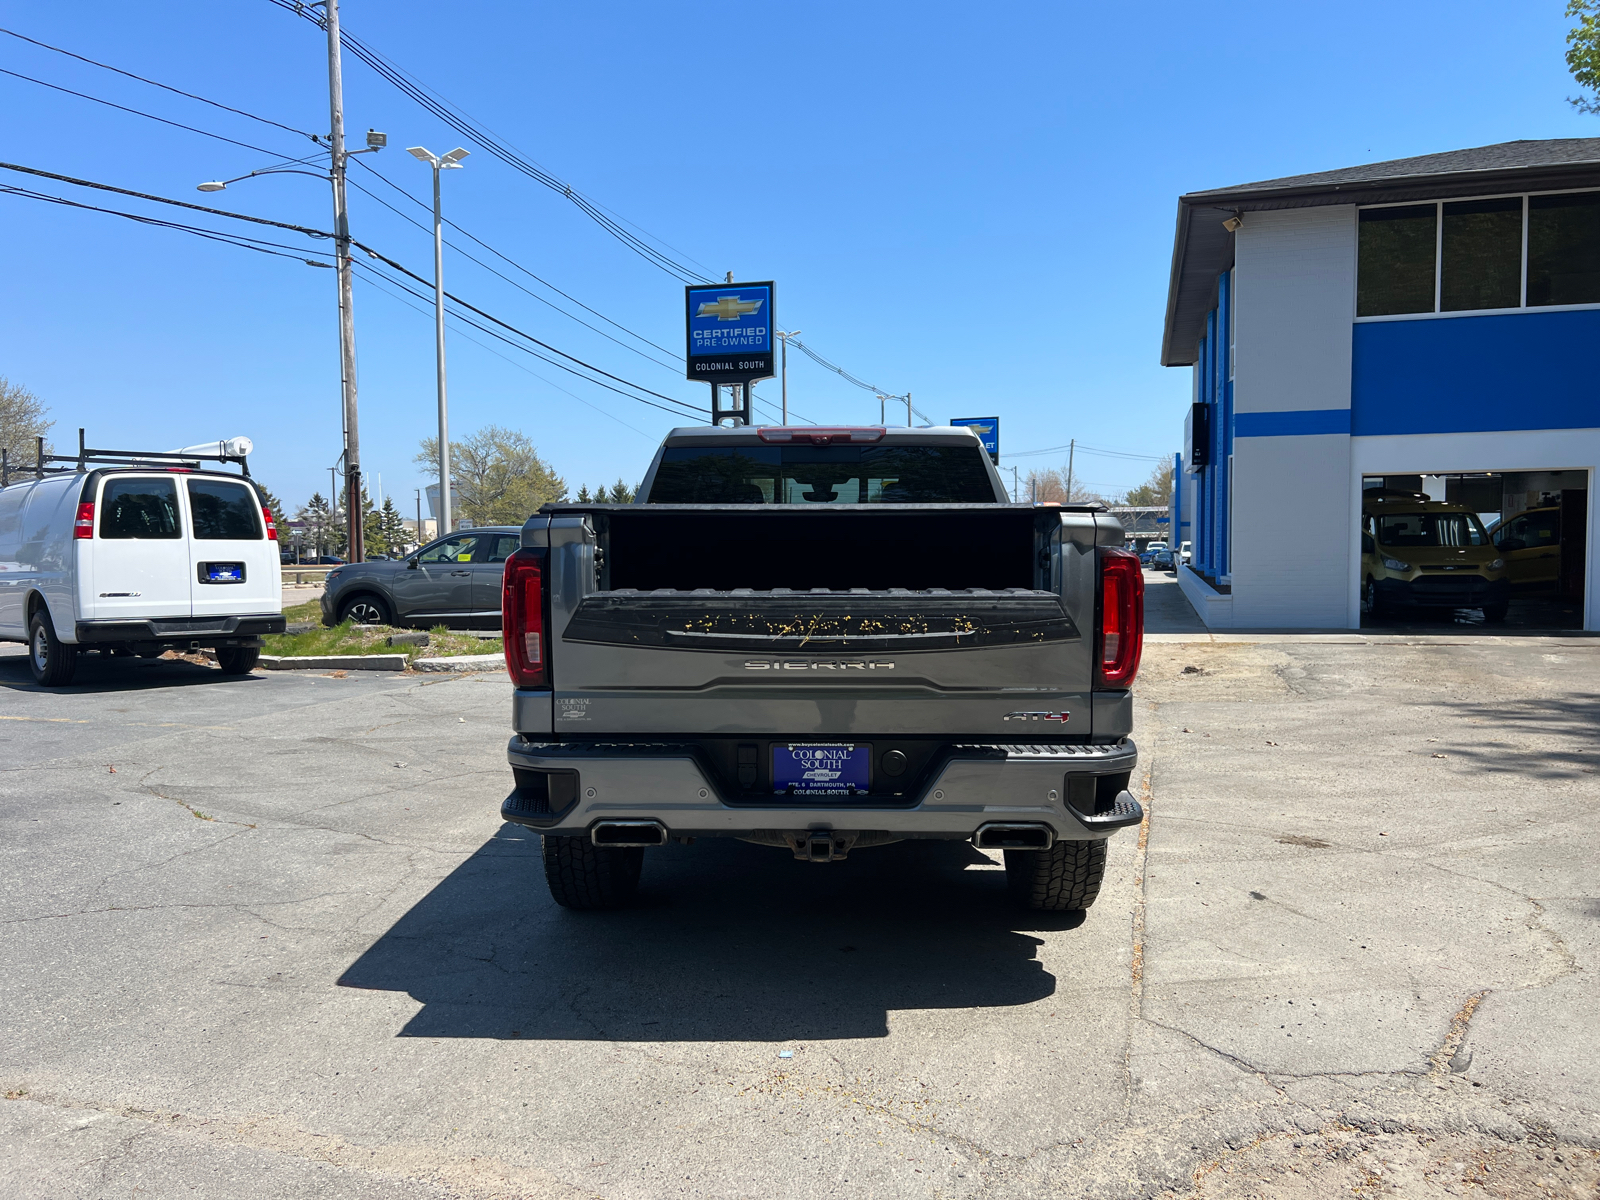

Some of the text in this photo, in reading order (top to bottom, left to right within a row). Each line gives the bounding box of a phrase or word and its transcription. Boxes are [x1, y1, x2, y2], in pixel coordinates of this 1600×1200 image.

[693, 327, 766, 338] CERTIFIED
[697, 336, 762, 347] PRE-OWNED
[696, 361, 764, 371] COLONIAL SOUTH
[744, 660, 895, 670] SIERRA
[1003, 711, 1070, 724] AT4
[792, 750, 851, 759] COLONIAL
[801, 760, 842, 768] SOUTH
